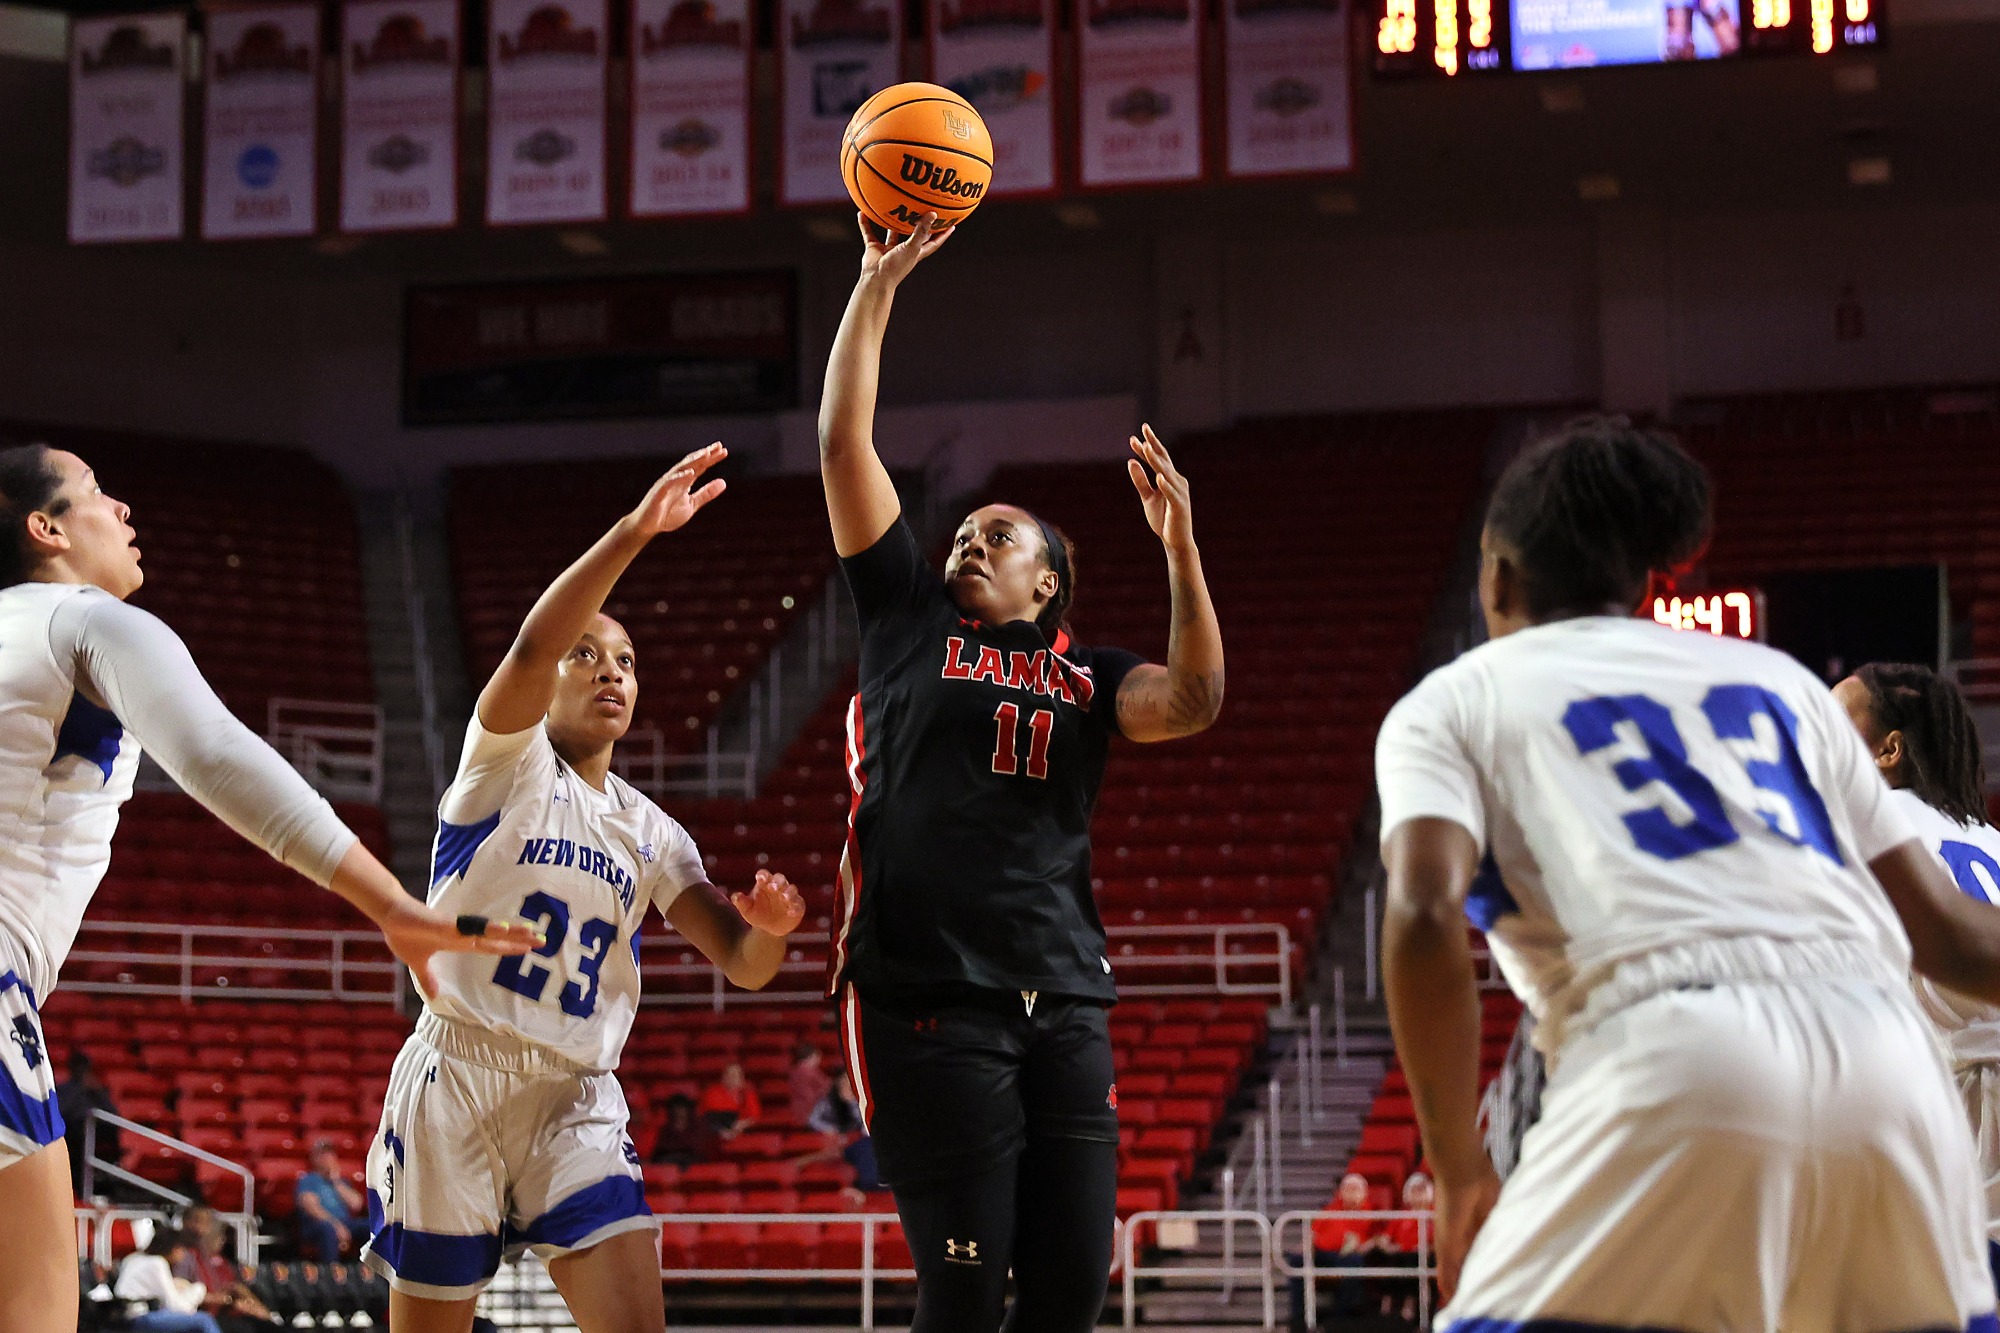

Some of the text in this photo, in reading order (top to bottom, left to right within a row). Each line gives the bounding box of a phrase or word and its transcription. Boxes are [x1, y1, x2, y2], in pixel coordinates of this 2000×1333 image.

[900, 153, 984, 199] Wilson
[1653, 592, 1752, 638] 4:47
[991, 701, 1054, 780] 11
[1562, 683, 1845, 867] 33
[516, 837, 576, 868] NEW
[492, 890, 618, 1019] 23
